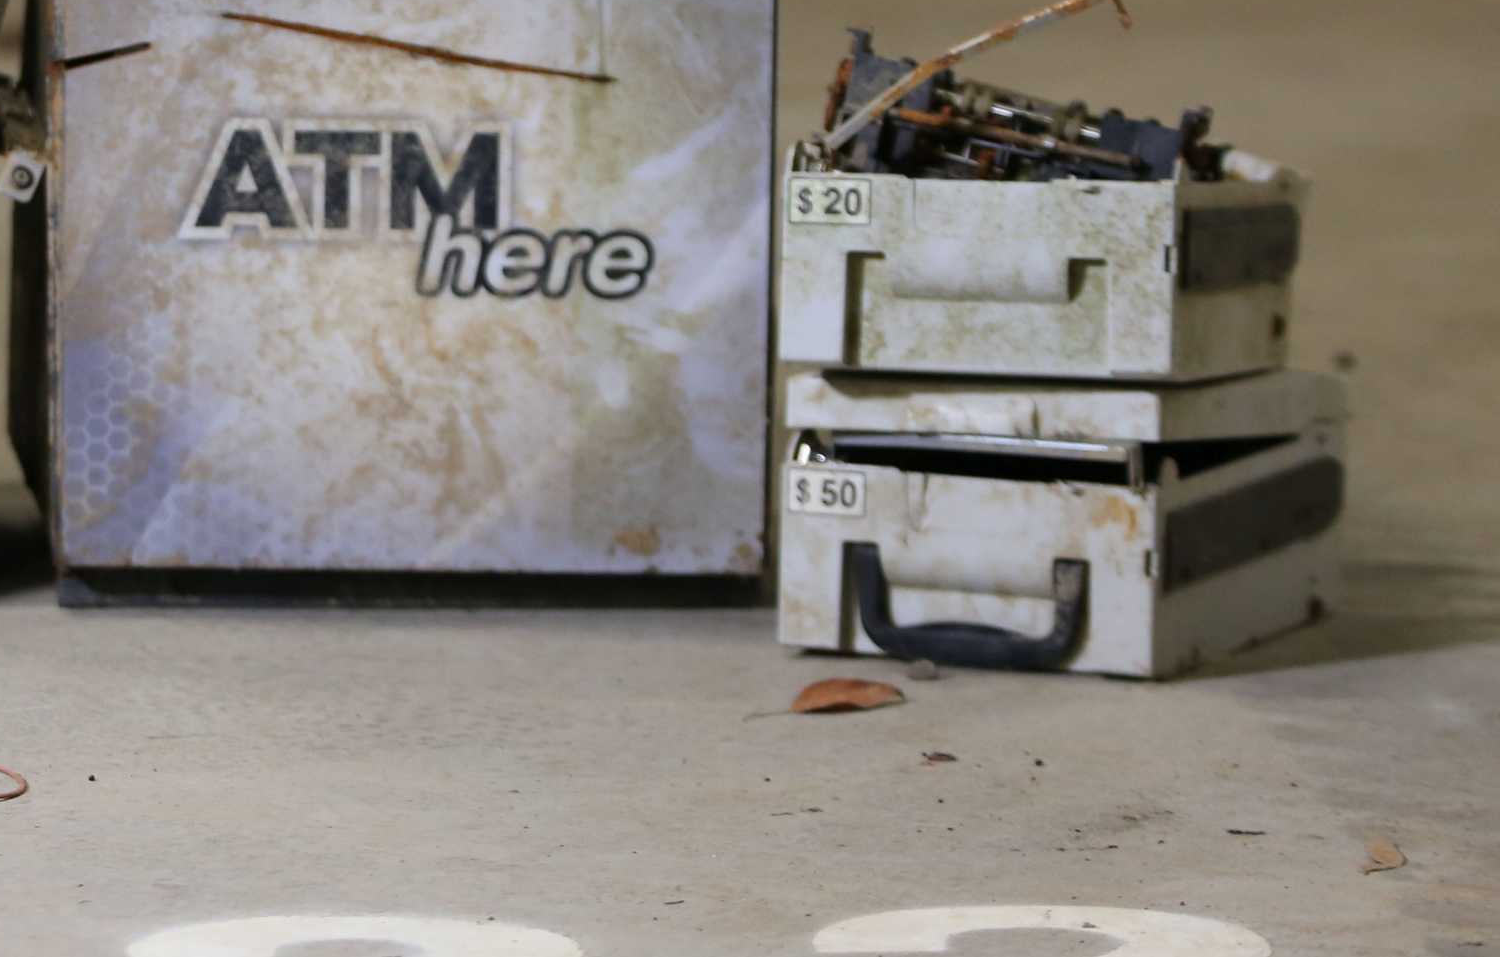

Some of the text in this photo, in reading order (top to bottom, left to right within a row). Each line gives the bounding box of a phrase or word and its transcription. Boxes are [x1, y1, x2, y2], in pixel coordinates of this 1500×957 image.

[186, 122, 506, 233] ATM
[798, 187, 863, 216] $ 20
[417, 212, 654, 299] here
[796, 477, 857, 508] $ 50
